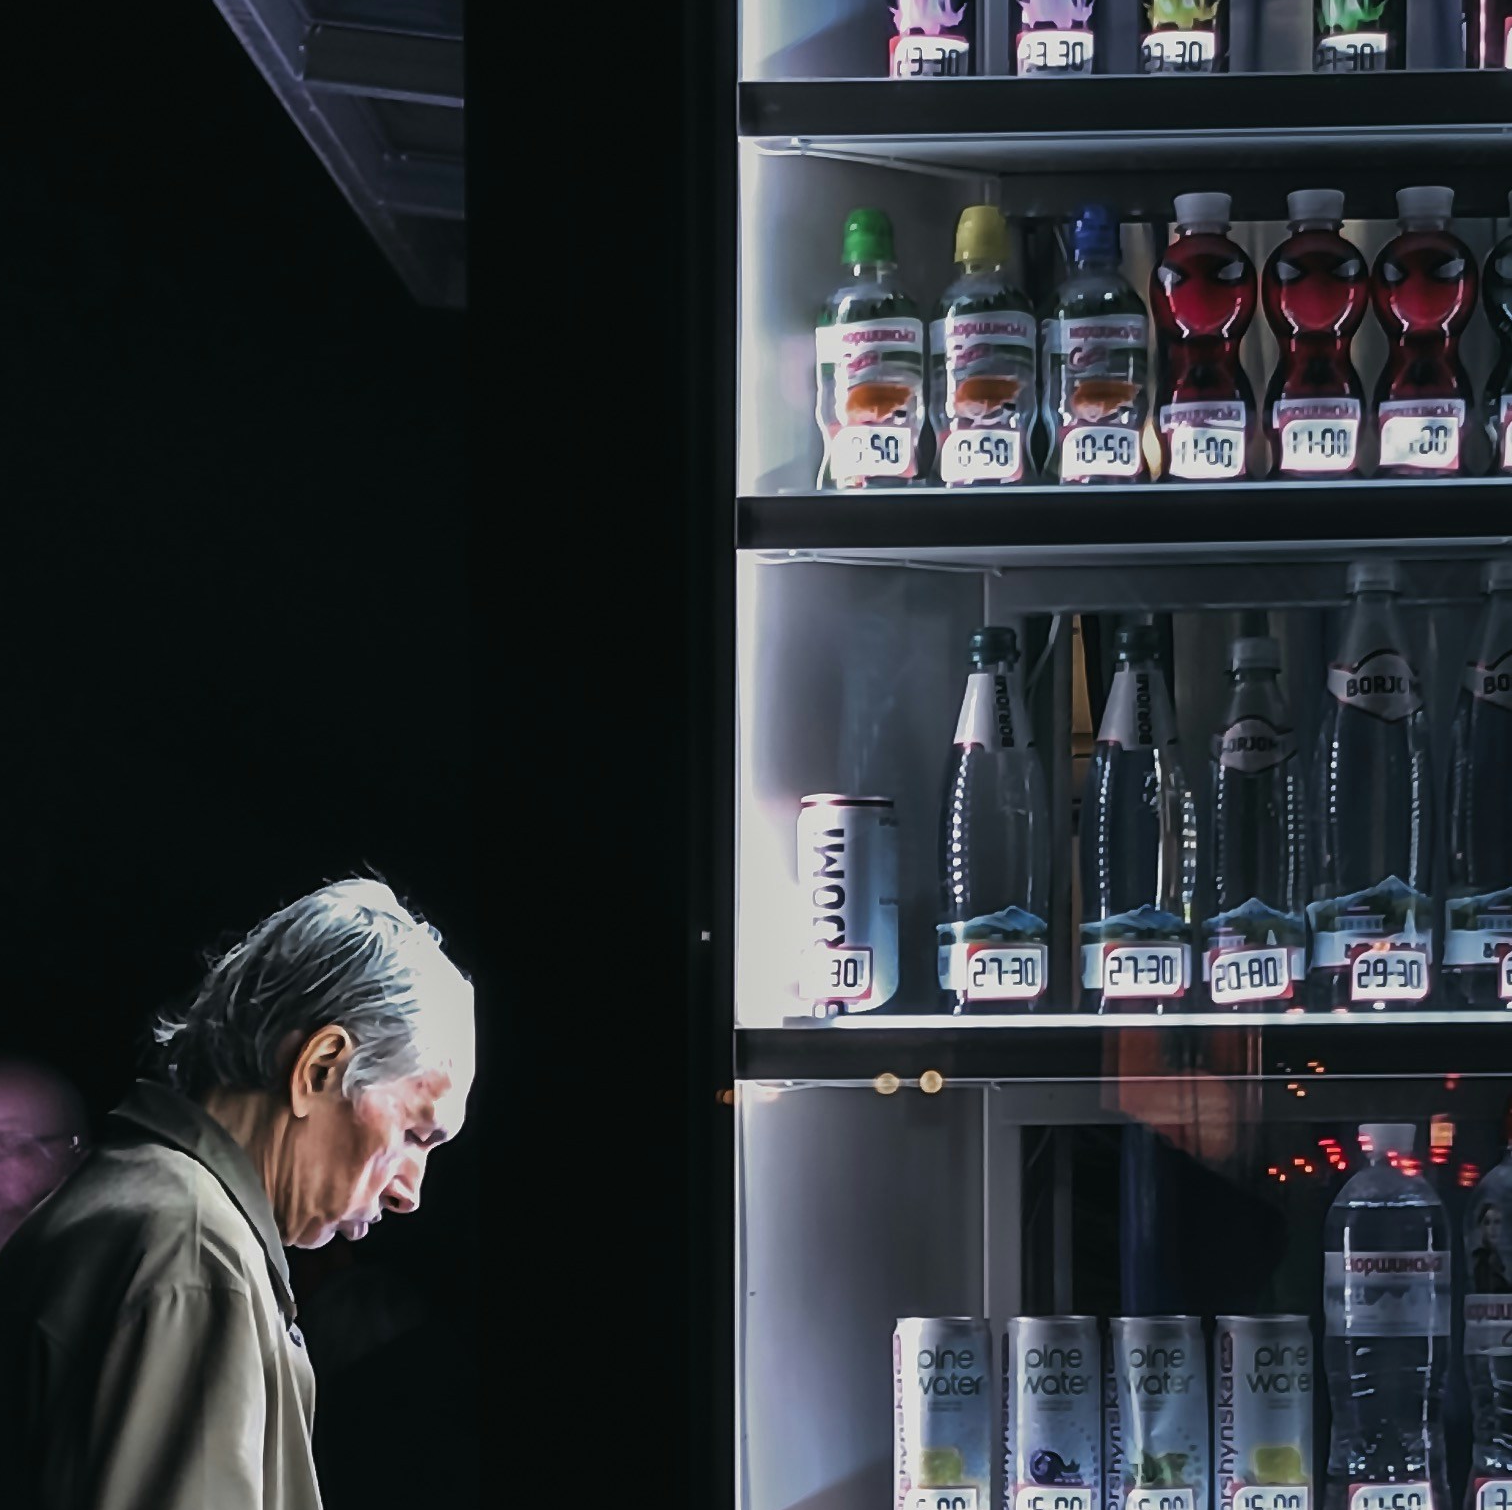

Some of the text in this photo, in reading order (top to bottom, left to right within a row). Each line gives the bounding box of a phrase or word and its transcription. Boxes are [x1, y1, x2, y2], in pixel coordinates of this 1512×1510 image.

[972, 957, 1036, 988] 27-30
[1109, 954, 1173, 986] 27-30
[1356, 957, 1421, 988] 29-30
[1247, 1371, 1311, 1394] wate
